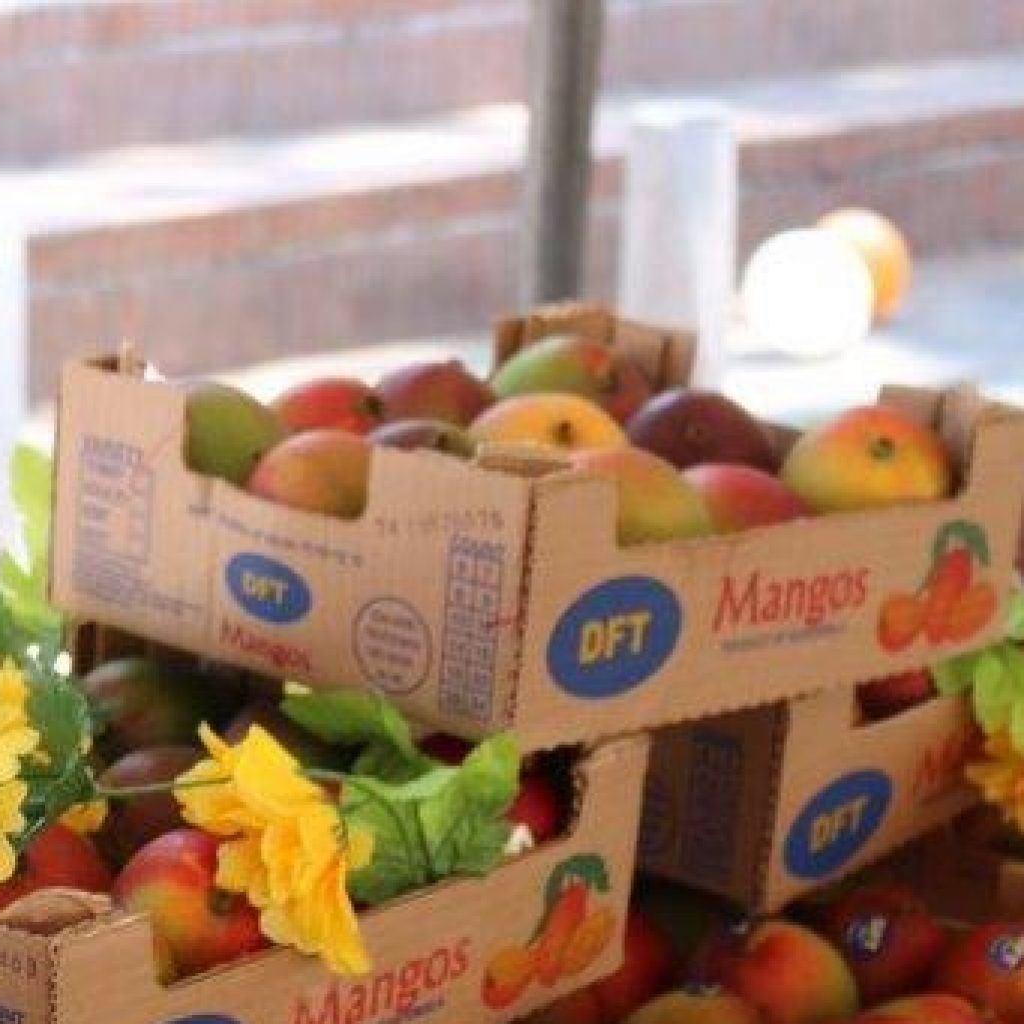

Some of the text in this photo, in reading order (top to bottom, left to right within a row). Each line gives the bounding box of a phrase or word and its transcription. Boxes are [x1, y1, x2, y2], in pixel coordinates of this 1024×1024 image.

[712, 567, 872, 634] Mangos
[579, 610, 652, 665] DFT
[809, 796, 868, 852] DFT
